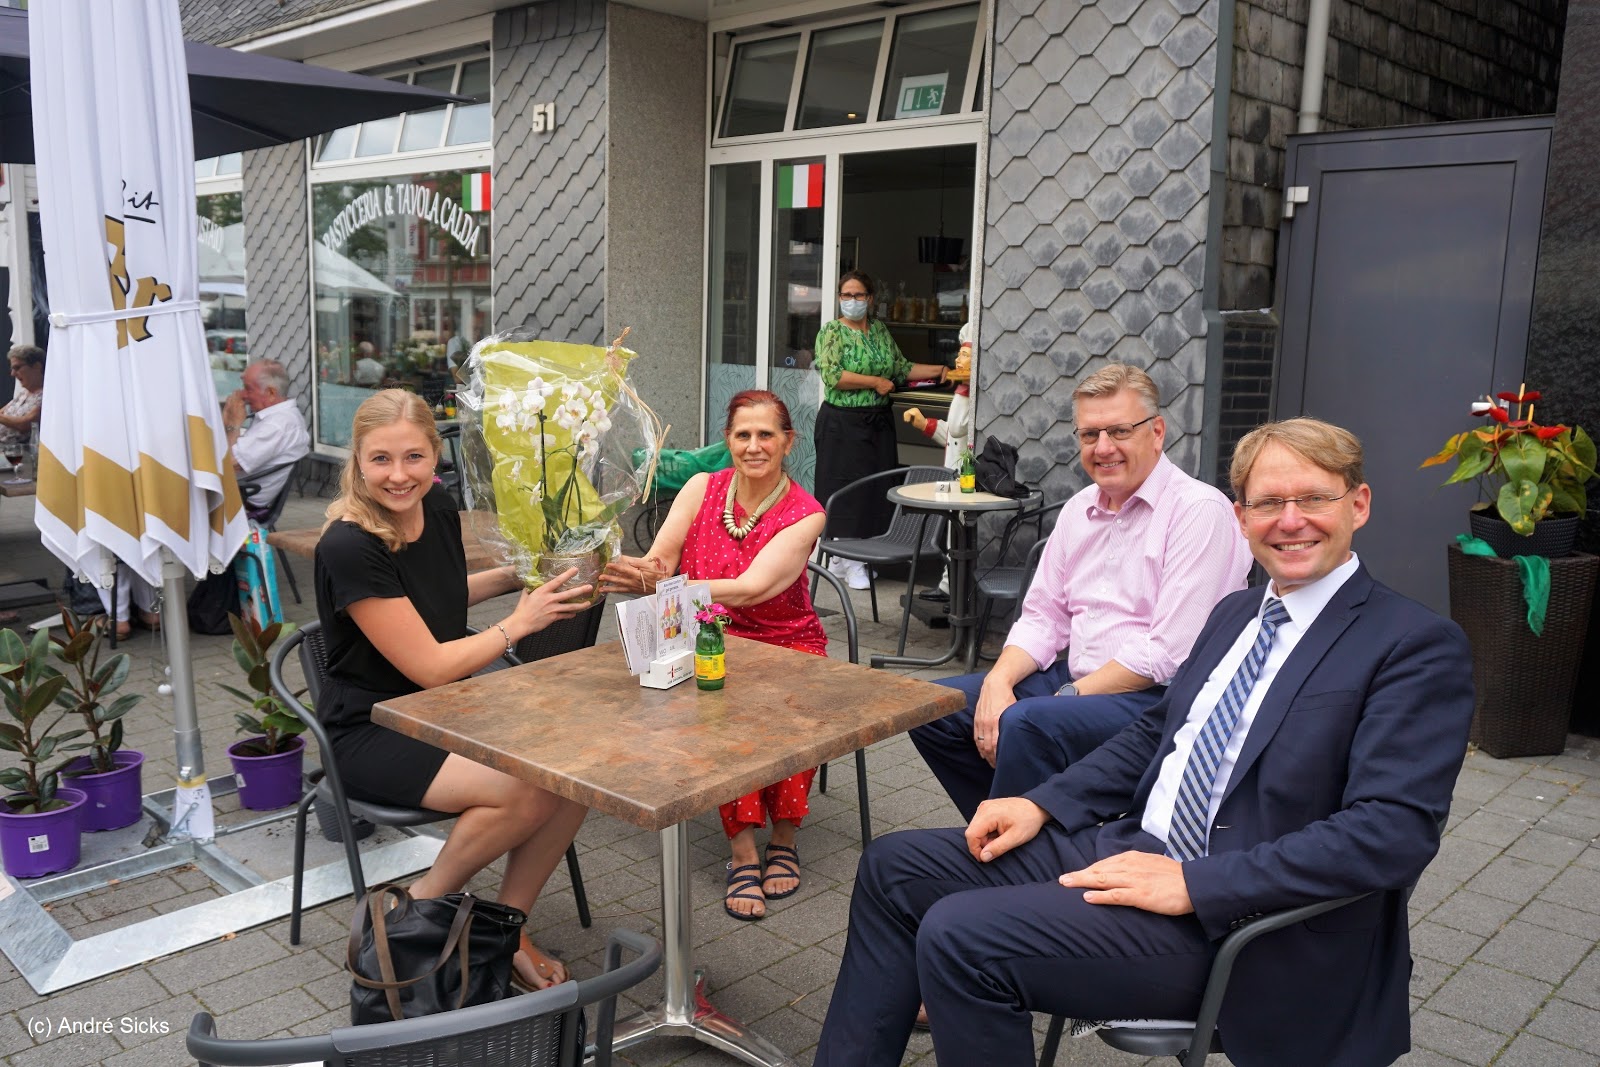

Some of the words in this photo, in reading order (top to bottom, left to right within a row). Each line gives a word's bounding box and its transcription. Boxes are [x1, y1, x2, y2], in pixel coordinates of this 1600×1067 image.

[532, 102, 555, 132] 51
[121, 179, 159, 210] it
[322, 187, 382, 256] PASTICCERIA
[384, 184, 394, 216] &
[396, 183, 439, 225] TAVOLA
[440, 197, 480, 257] CALDA
